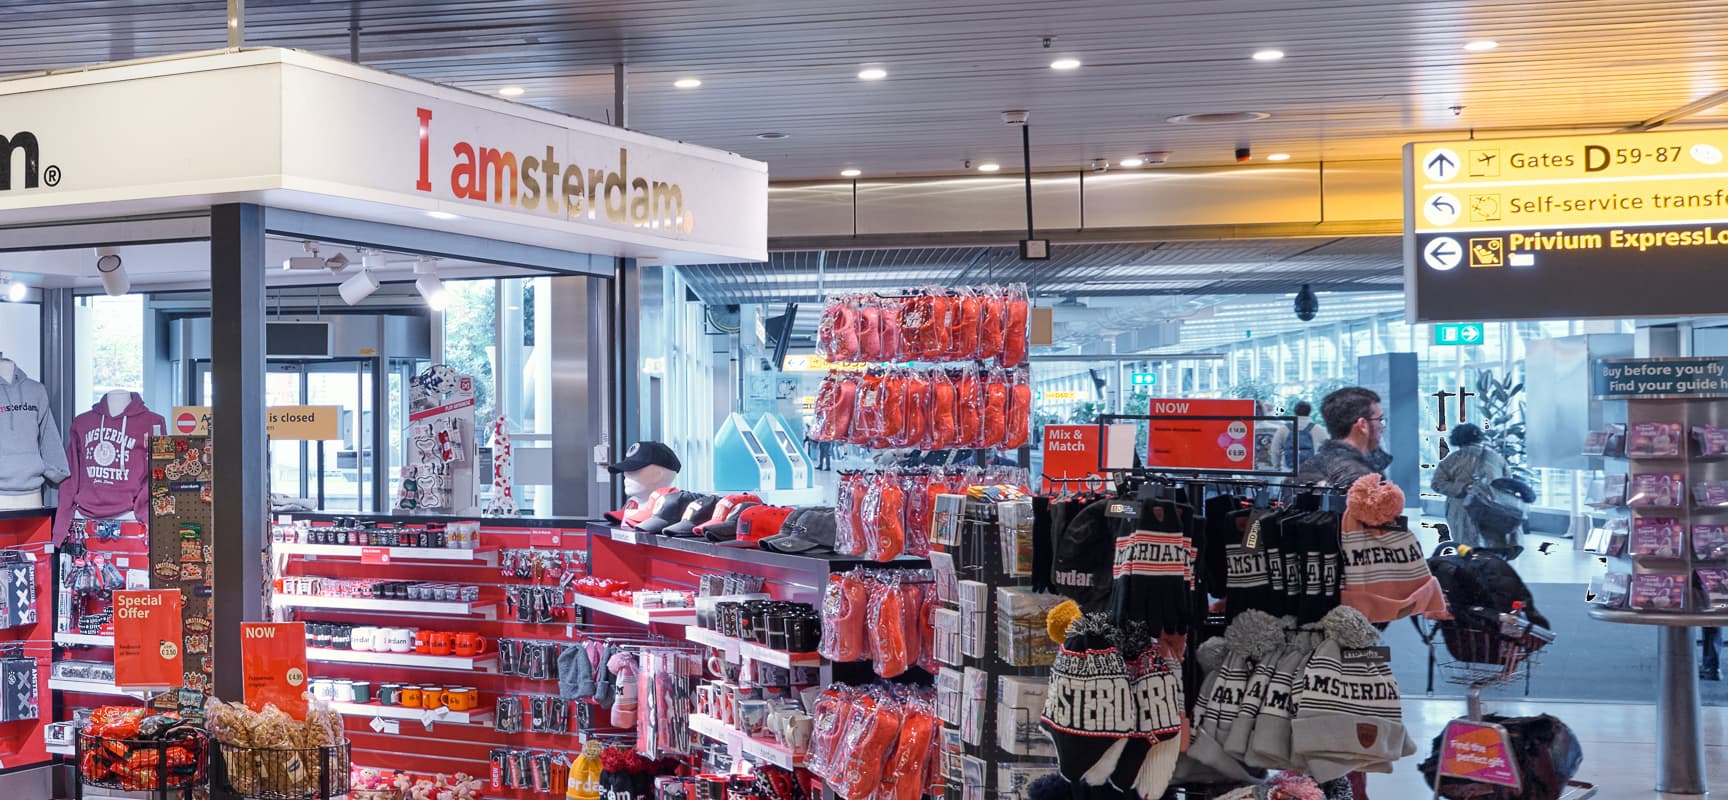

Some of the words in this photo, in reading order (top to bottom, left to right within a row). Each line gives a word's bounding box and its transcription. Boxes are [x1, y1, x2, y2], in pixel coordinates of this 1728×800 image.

[416, 107, 433, 192] I
[1510, 152, 1574, 169] Gates
[1584, 145, 1611, 172] D
[1616, 146, 1682, 164] 59-87
[1510, 194, 1643, 214] Self-service
[1652, 189, 1728, 209] transf
[1510, 231, 1602, 251] Privium
[1603, 366, 1621, 379] Buy
[1624, 364, 1671, 377] before
[1675, 366, 1703, 377] you
[1707, 363, 1724, 375] fly
[1610, 380, 1634, 391] Find
[1638, 381, 1672, 393] your
[1676, 379, 1717, 393] guide
[1155, 402, 1189, 414] NOW
[269, 412, 278, 423] is
[281, 412, 315, 423] closed
[1049, 430, 1070, 440] Mix
[1073, 430, 1082, 440] &
[1049, 441, 1085, 452] Match
[118, 595, 162, 607] Special
[118, 608, 150, 618] Offer
[246, 627, 275, 638] NOW
